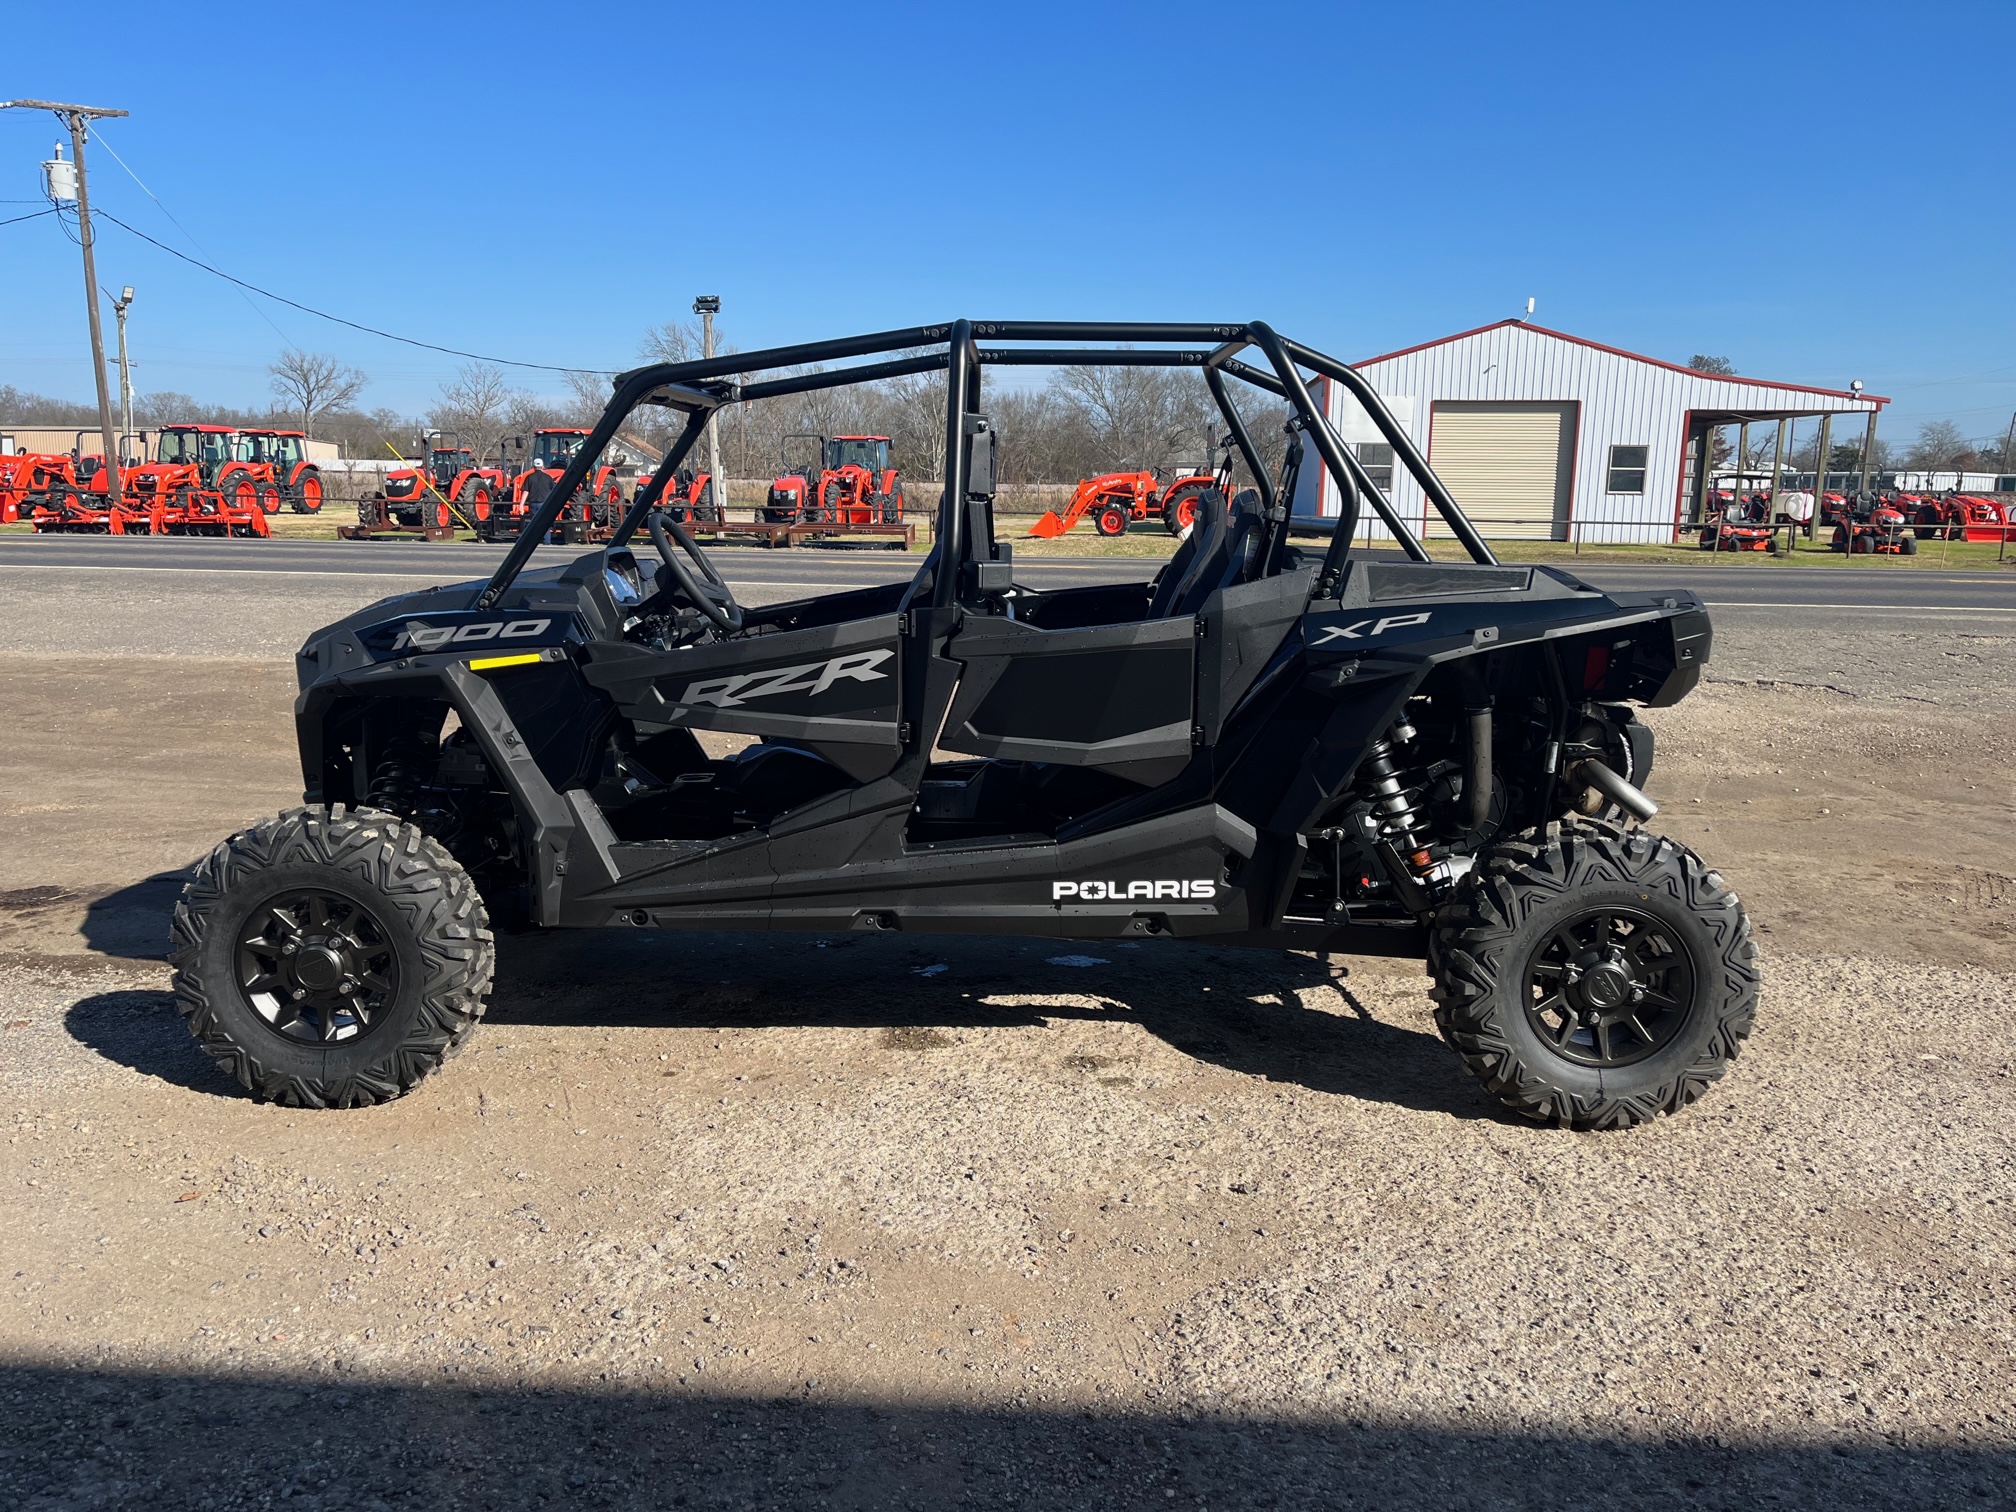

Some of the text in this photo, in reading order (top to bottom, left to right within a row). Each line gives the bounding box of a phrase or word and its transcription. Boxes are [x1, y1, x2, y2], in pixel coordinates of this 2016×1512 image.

[391, 619, 551, 650] 1000
[1309, 612, 1432, 646] XP
[669, 648, 895, 721] RZR
[1052, 880, 1216, 900] POLARIS
